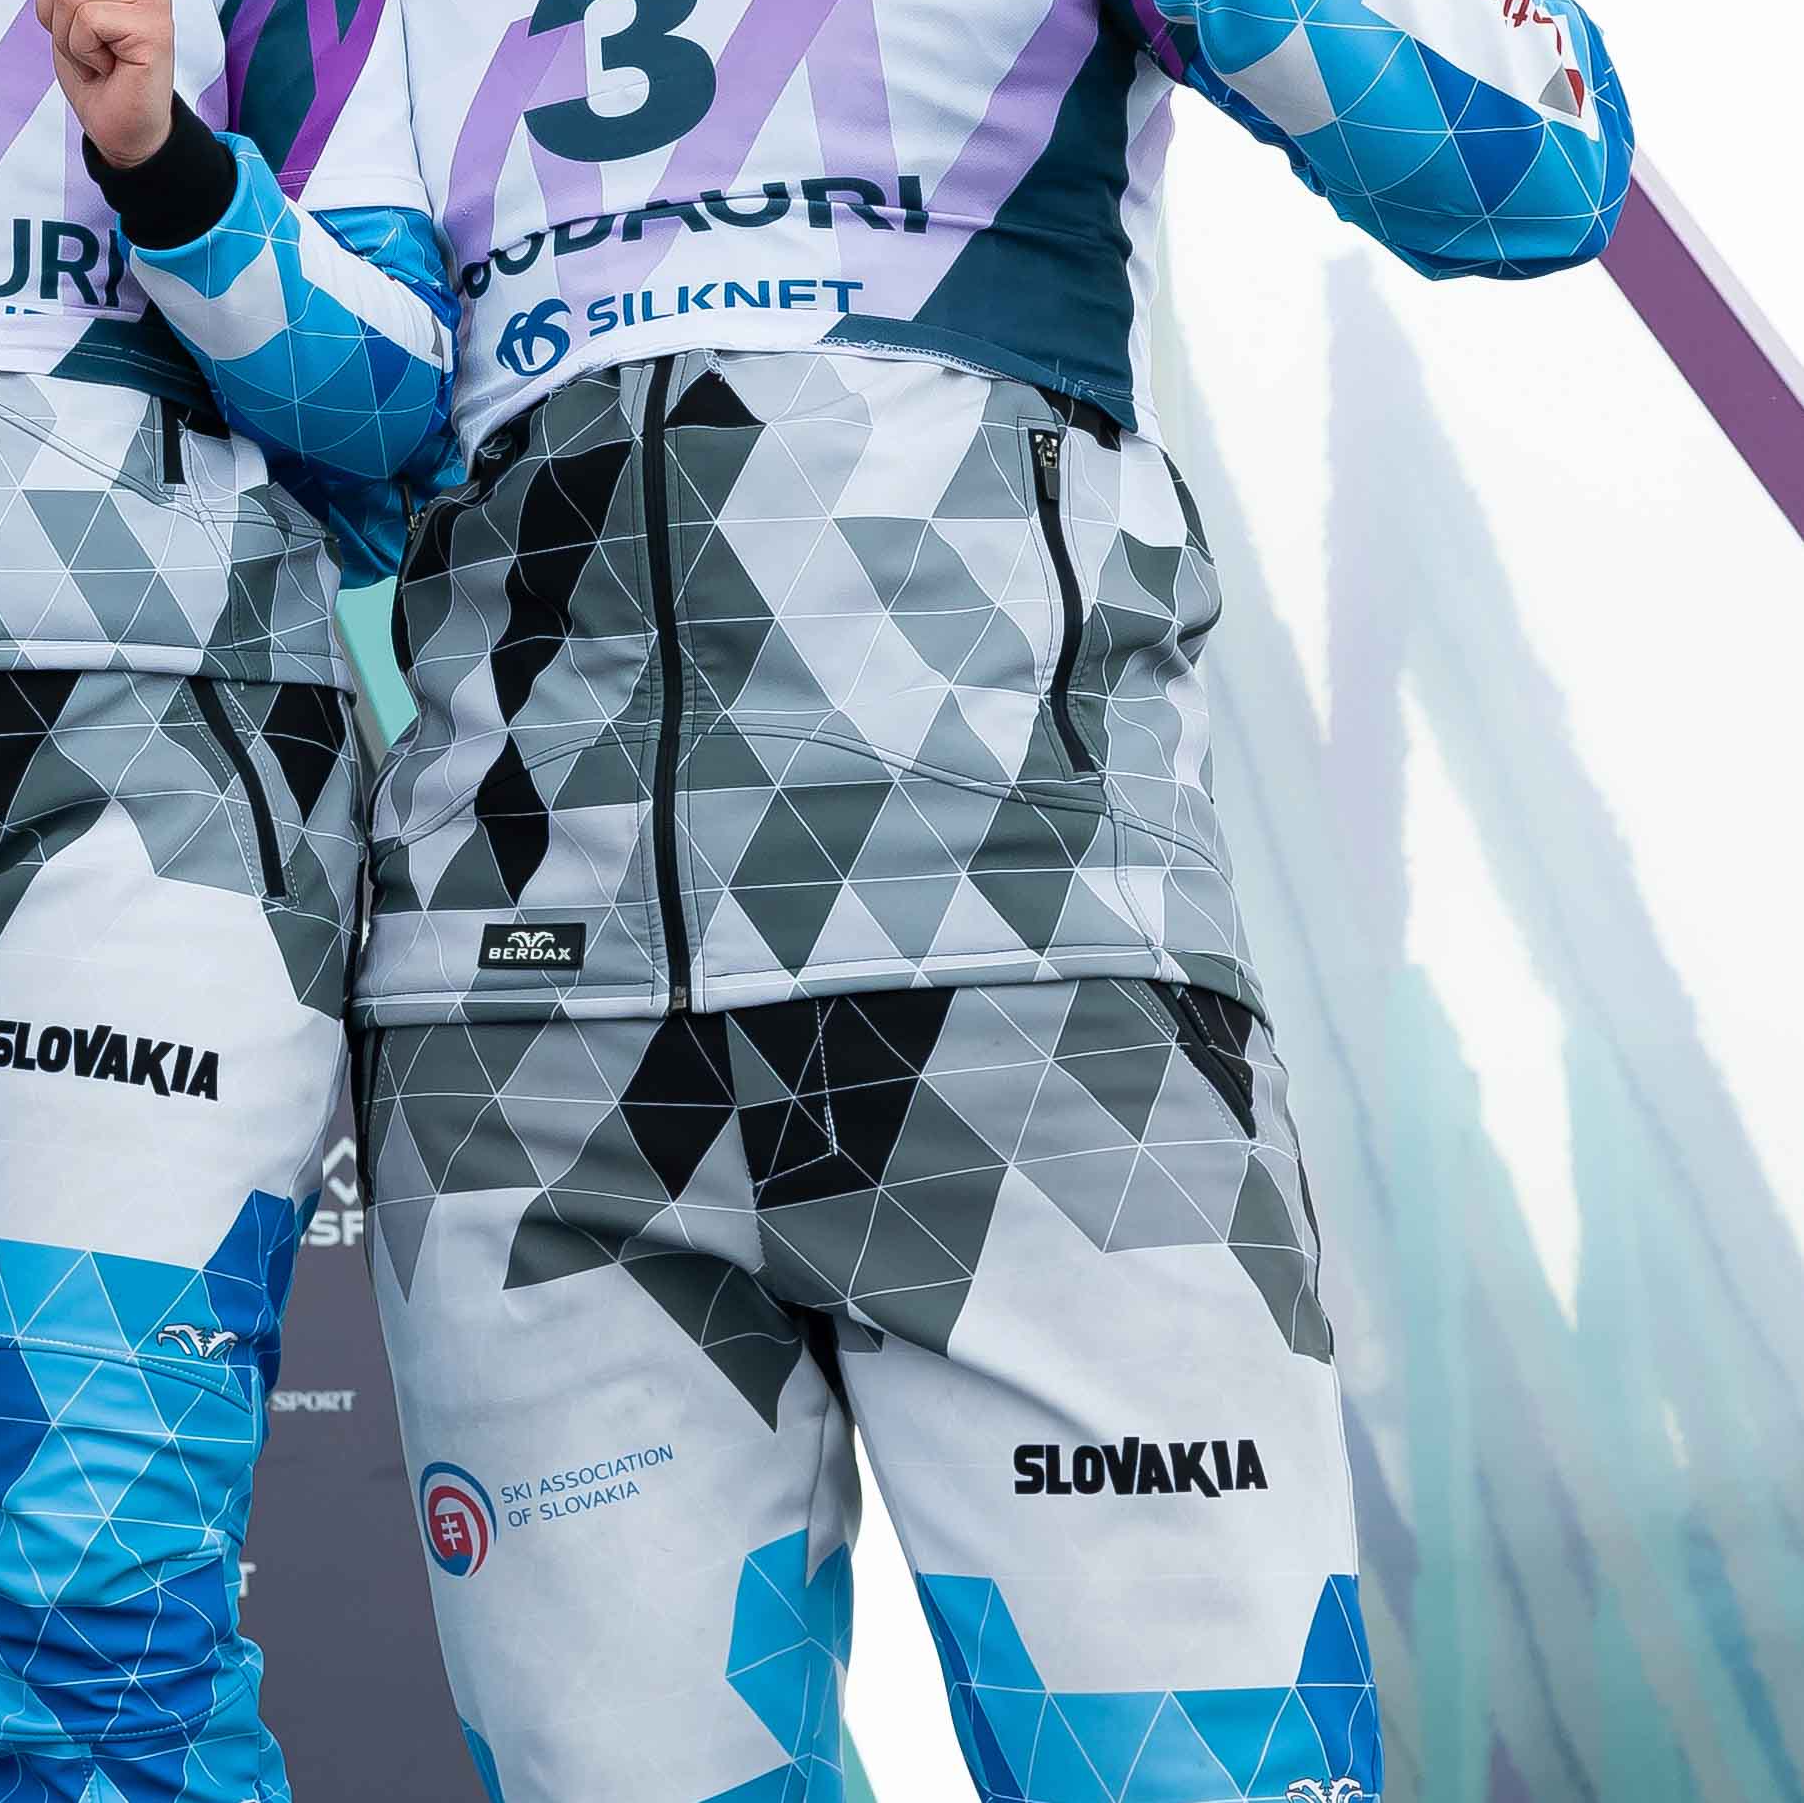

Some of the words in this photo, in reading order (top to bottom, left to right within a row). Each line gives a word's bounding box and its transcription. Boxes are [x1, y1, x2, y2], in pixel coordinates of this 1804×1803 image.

[488, 947, 572, 961] BERDAX
[271, 1391, 356, 1413] SPORT
[500, 1481, 533, 1504] SKI
[539, 1443, 674, 1496] ASSOCIATION
[1012, 1435, 1269, 1500] SLOVAKIA
[508, 1507, 533, 1528] OF
[539, 1480, 641, 1521] SLOVAKIA
